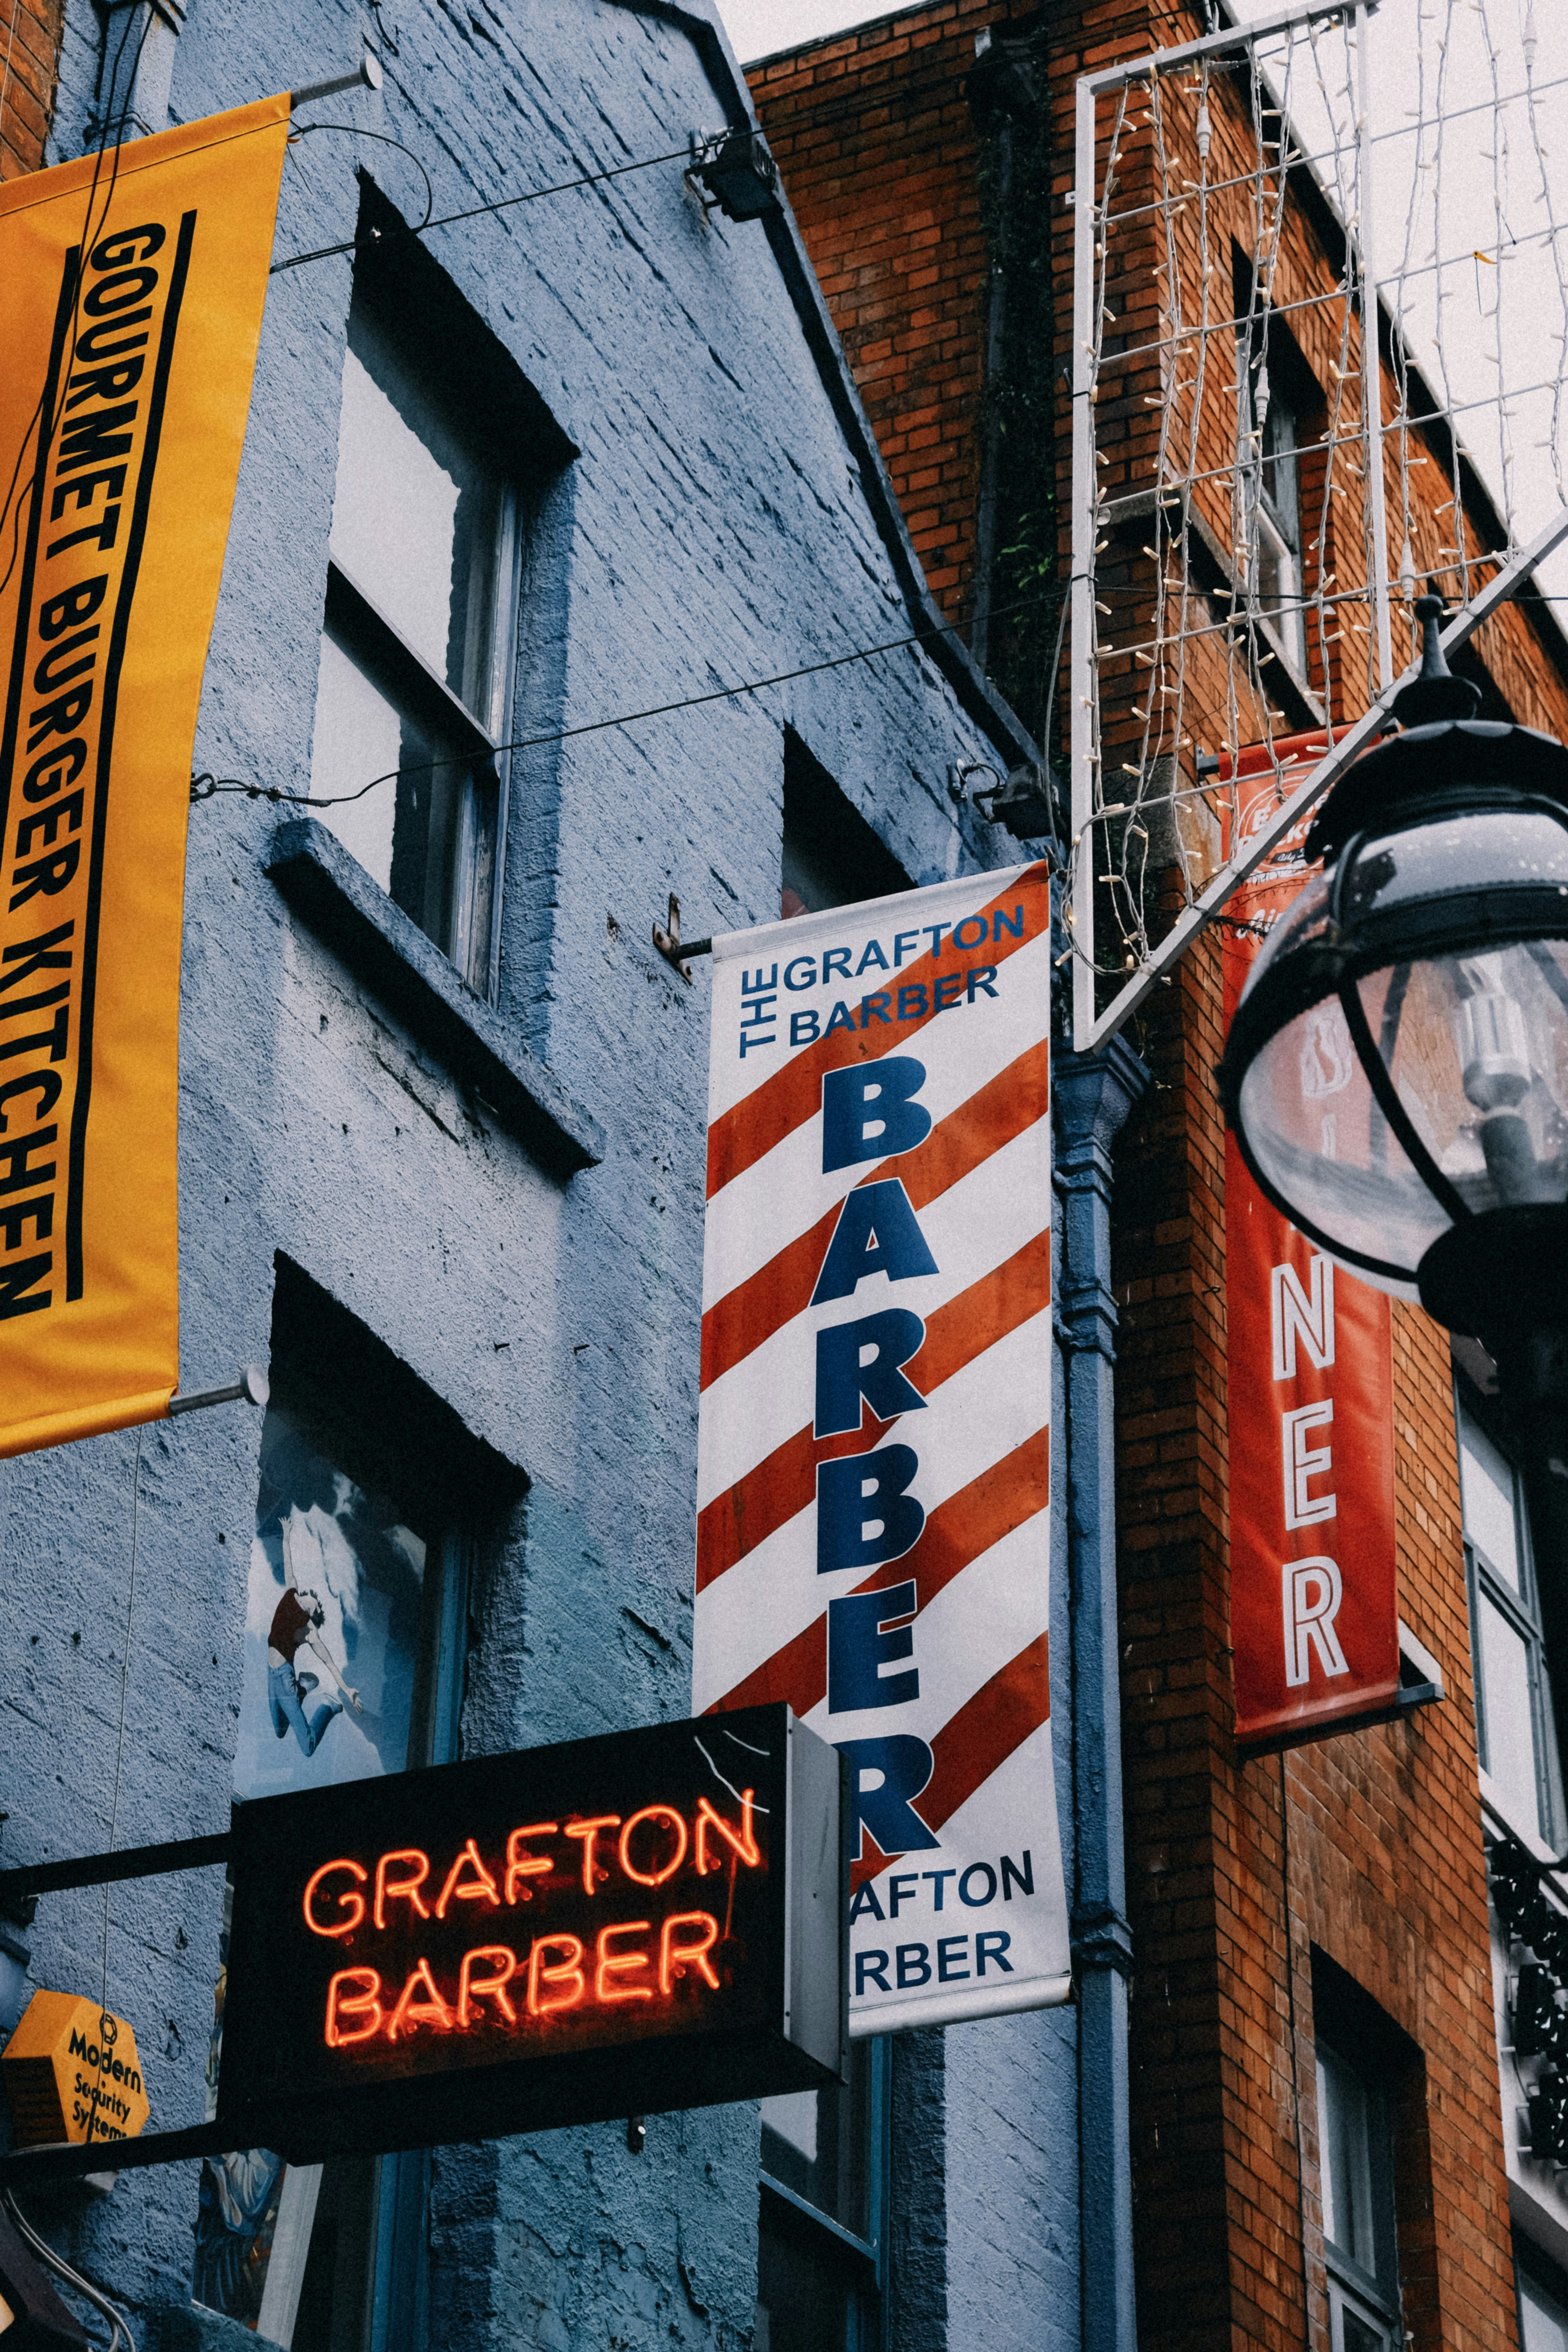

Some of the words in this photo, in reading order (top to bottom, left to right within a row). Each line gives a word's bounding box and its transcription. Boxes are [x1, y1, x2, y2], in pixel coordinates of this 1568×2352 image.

[46, 222, 166, 561] GOURMET
[8, 573, 109, 914] BURGER
[783, 905, 1024, 992] GRAFTON
[740, 962, 778, 1059] THE
[790, 965, 1000, 1047] BARBER
[0, 919, 75, 1319] KITCHEN
[810, 1056, 942, 1861] BARBER
[303, 1789, 760, 1937] GRAFTON
[850, 1849, 1035, 1926] AFTON
[325, 1911, 720, 2046] BARBER
[850, 1930, 1015, 1997] RBER
[68, 2027, 141, 2095] Modern
[75, 2072, 131, 2125] Security
[72, 2100, 127, 2139] Sytem
